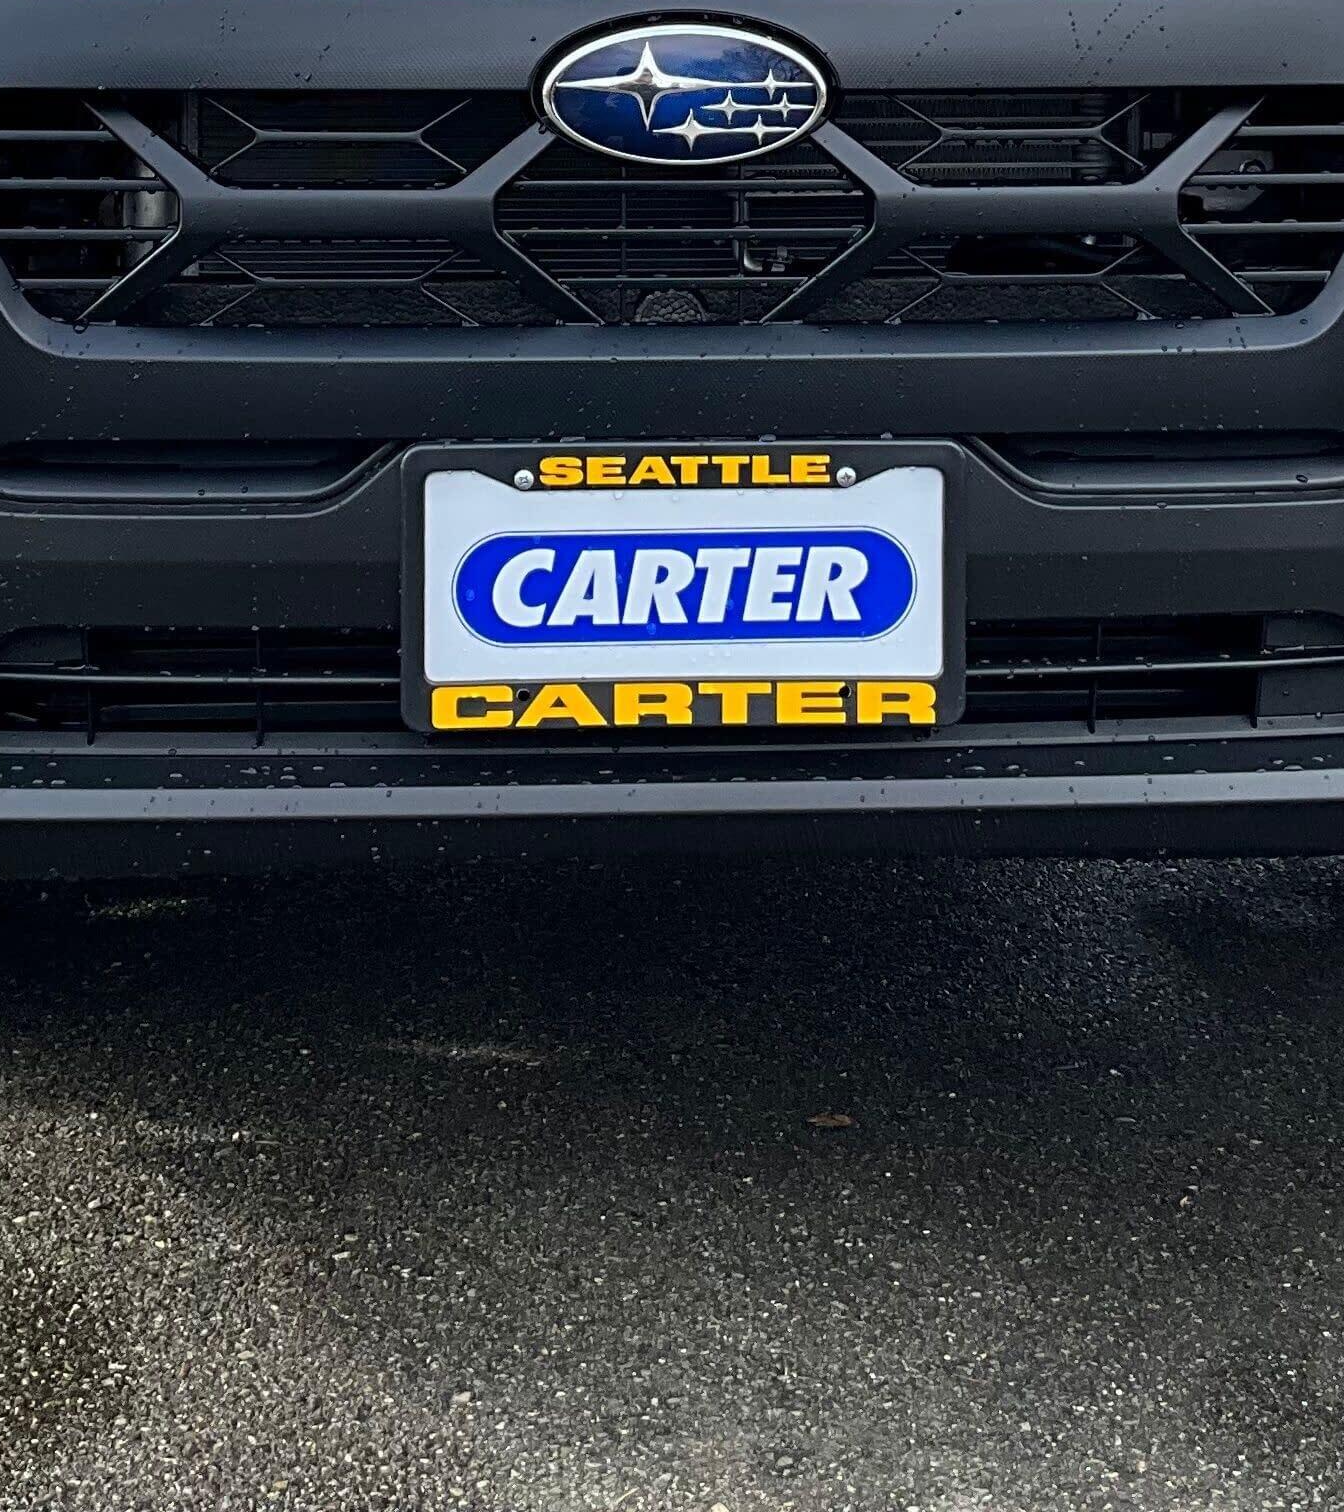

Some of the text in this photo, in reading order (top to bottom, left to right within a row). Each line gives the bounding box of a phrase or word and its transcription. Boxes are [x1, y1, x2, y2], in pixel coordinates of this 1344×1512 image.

[538, 453, 831, 486] SEATTLE
[491, 545, 870, 629] CARTER
[431, 681, 938, 730] CARTER
